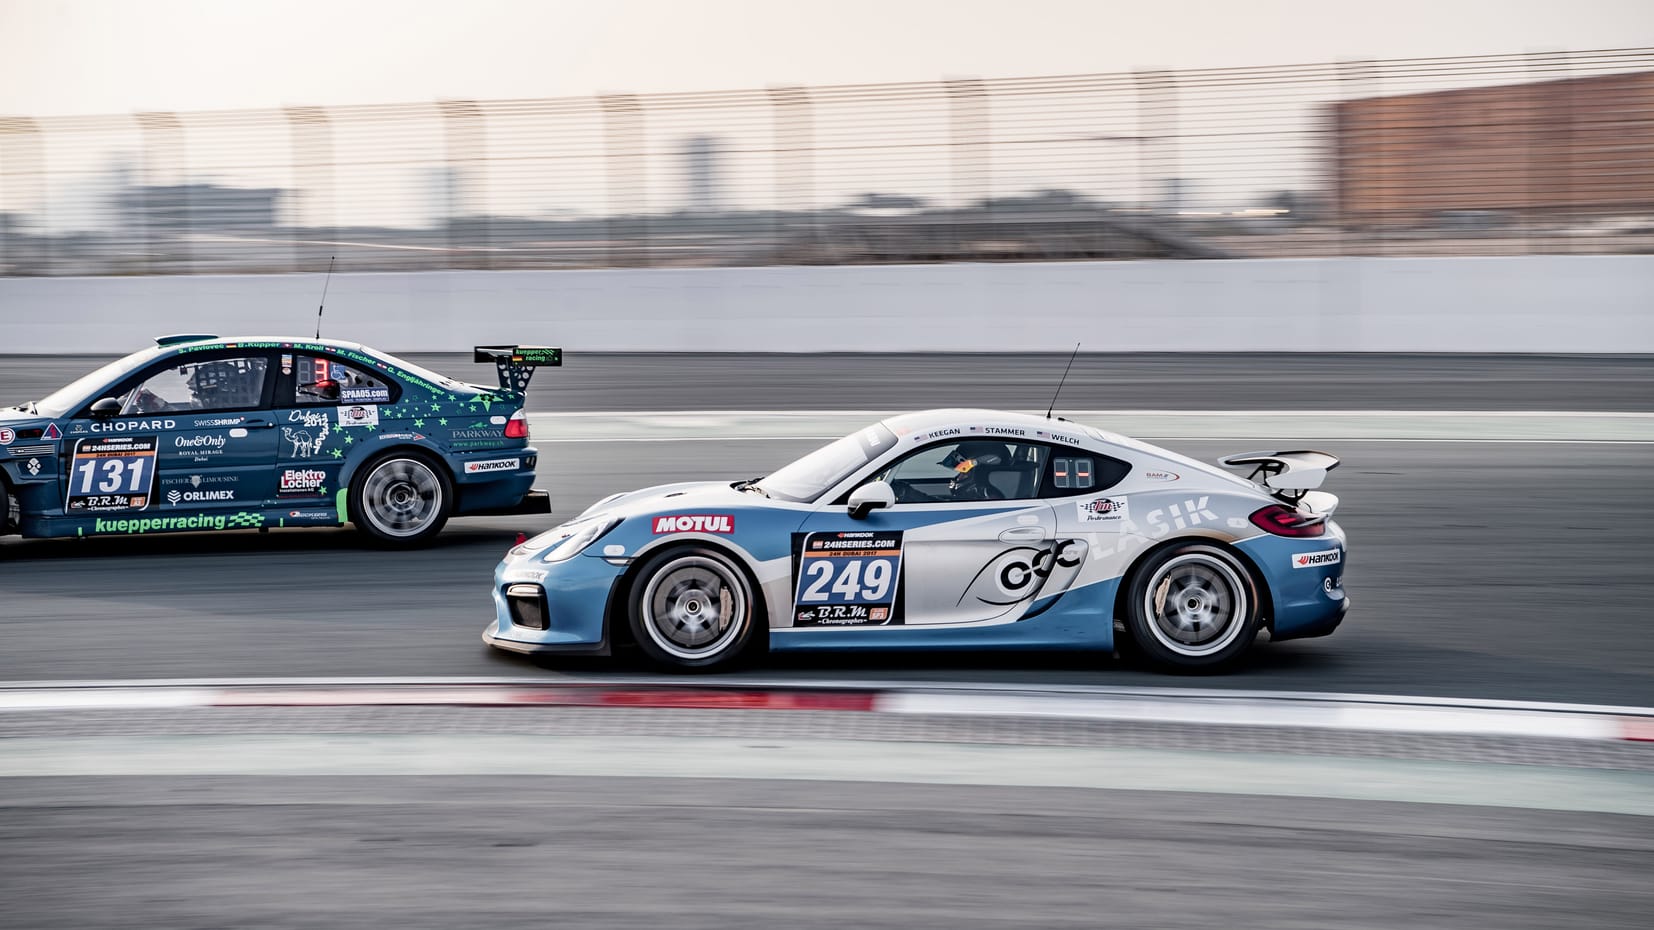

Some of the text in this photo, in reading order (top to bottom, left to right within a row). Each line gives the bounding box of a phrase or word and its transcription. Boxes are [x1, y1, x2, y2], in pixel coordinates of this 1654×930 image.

[91, 420, 175, 432] CHOPARD
[984, 427, 1025, 437] STAMMER
[452, 430, 504, 439] PARKWAY
[928, 427, 961, 439] KEEGAN
[1051, 433, 1080, 446] WELCH
[174, 434, 226, 449] One&Only
[79, 458, 144, 493] 131
[284, 469, 327, 480] Elektro
[280, 476, 323, 489] Locher
[183, 490, 235, 501] ORLIMEX
[95, 513, 226, 533] kuepperracing
[655, 516, 732, 533] MOTUL
[1087, 496, 1218, 560] LASIK
[823, 540, 896, 549] 24HSERIES.COM
[801, 560, 892, 601] 249
